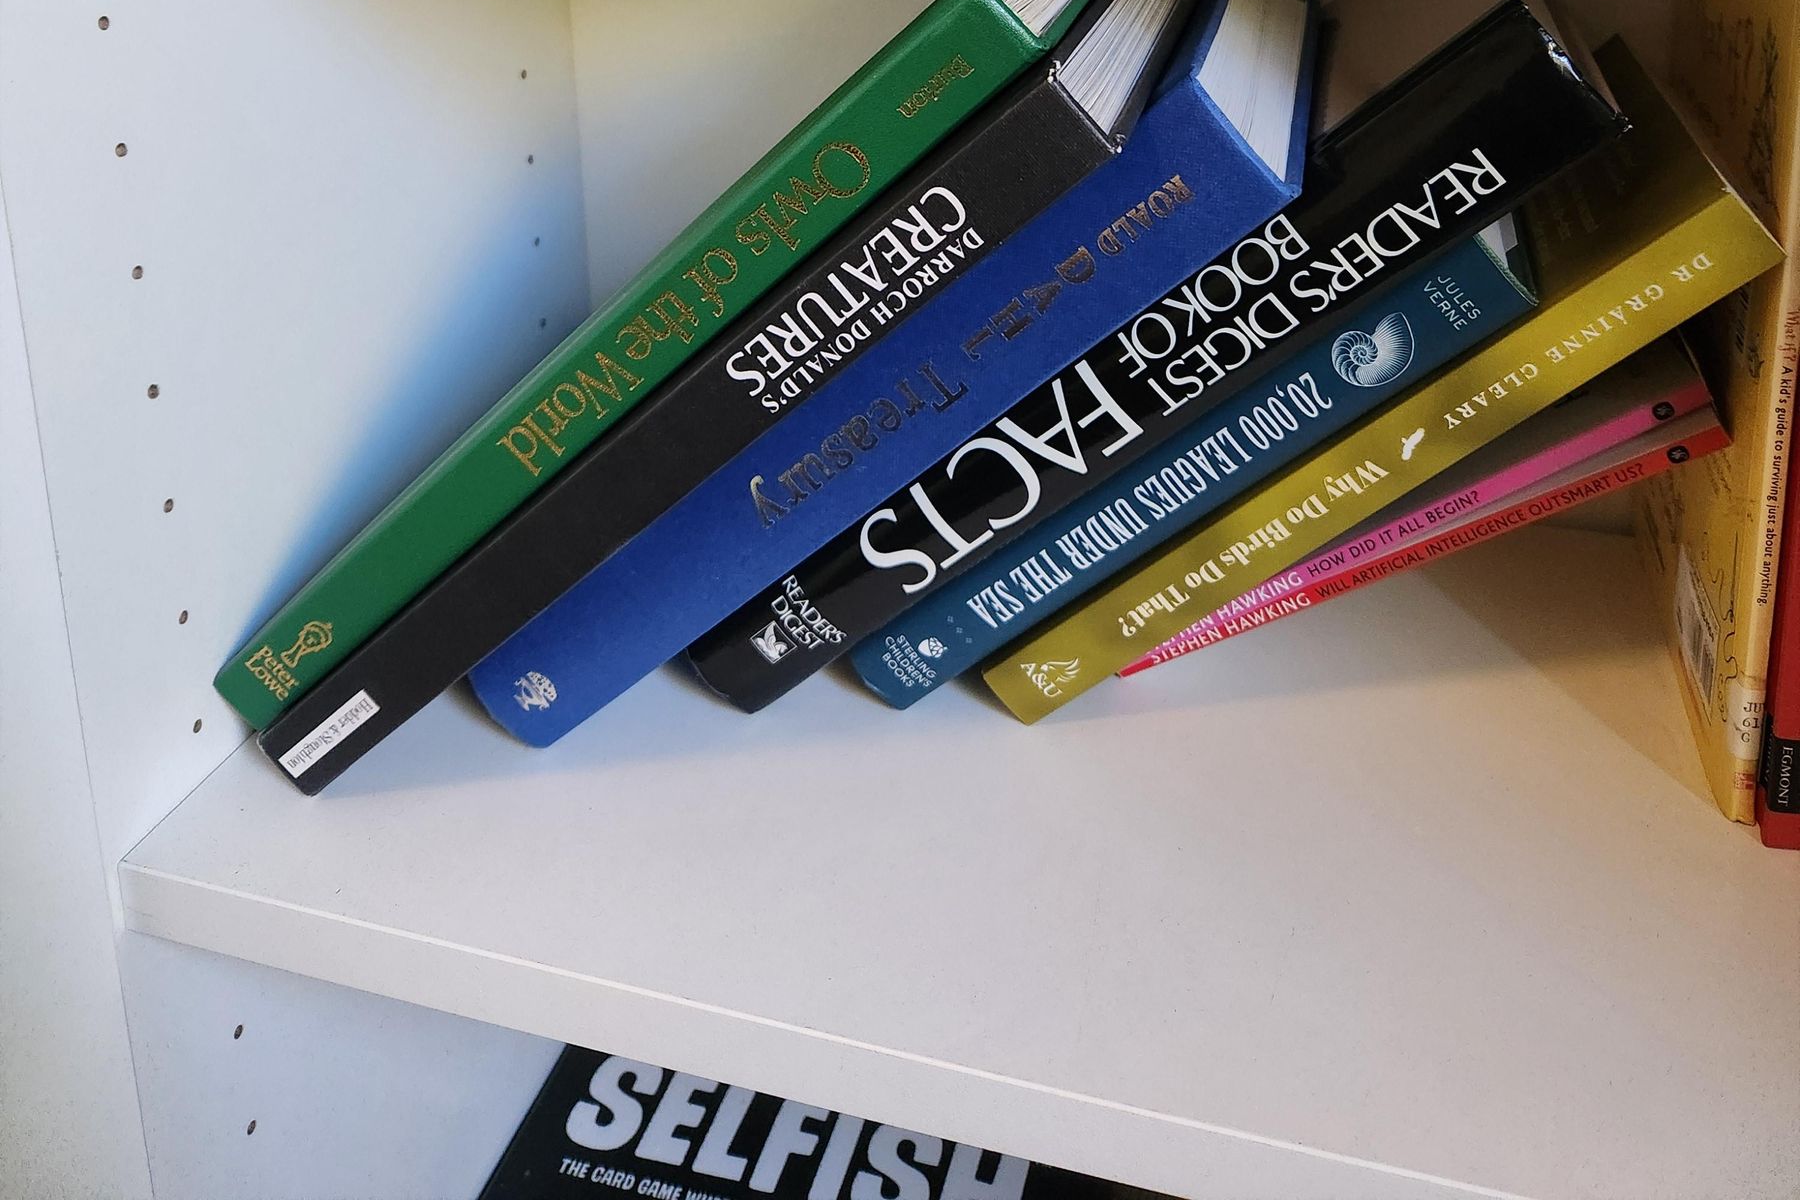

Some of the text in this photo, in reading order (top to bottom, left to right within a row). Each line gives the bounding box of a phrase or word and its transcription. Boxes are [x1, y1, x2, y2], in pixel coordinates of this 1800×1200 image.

[1096, 174, 1195, 257] ROALD
[725, 186, 967, 398] CREATURES
[1117, 213, 1311, 379] BOOK OF
[1147, 147, 1508, 418] READER'S DIGEST
[1436, 274, 1481, 321] JULES
[1670, 252, 1715, 283] DR
[496, 140, 871, 477] Owls of the World
[760, 227, 985, 414] DARROCH DONALD'S
[961, 245, 1097, 362] DAHL
[1423, 280, 1468, 332] VERNE
[1443, 362, 1540, 430] CLEARY
[748, 360, 970, 530] Treasury
[859, 359, 1144, 595] FACTS
[1764, 378, 1792, 557] kid's guide to surviving just about
[966, 371, 1333, 629] 20,000 LEAGUES UNDER THE SEA
[1286, 493, 1330, 526] Do
[1323, 459, 1391, 502] Why
[1151, 625, 1222, 664] STEPHEN
[1224, 592, 1312, 635] HAWKING
[1314, 580, 1351, 600] WILL
[1351, 550, 1425, 585] ARTIFICIAL
[1425, 509, 1527, 558] INTELLIGENCE
[1528, 475, 1612, 517] OUTSMART
[1615, 463, 1645, 484] US?
[1184, 558, 1226, 590] Do
[1215, 490, 1481, 621] HAWKING HOW DID IT ALL BEGIN?
[1220, 518, 1293, 567] Birds
[771, 574, 848, 650] READER'S DIGEST
[1118, 582, 1191, 639] That?
[244, 652, 289, 701] Lowe
[257, 645, 300, 689] Peter
[881, 652, 915, 688] BOOKS
[884, 636, 933, 688] CHILDREN'S
[897, 634, 937, 679] STERLING
[1019, 661, 1063, 698] A&U
[287, 698, 374, 770] Hodder Stoughton
[1777, 745, 1794, 807] EGMONT
[565, 1053, 1031, 1200] SELFISH
[558, 1158, 592, 1179] THE
[590, 1166, 636, 1191] CARD
[637, 1179, 683, 1200] GAME
